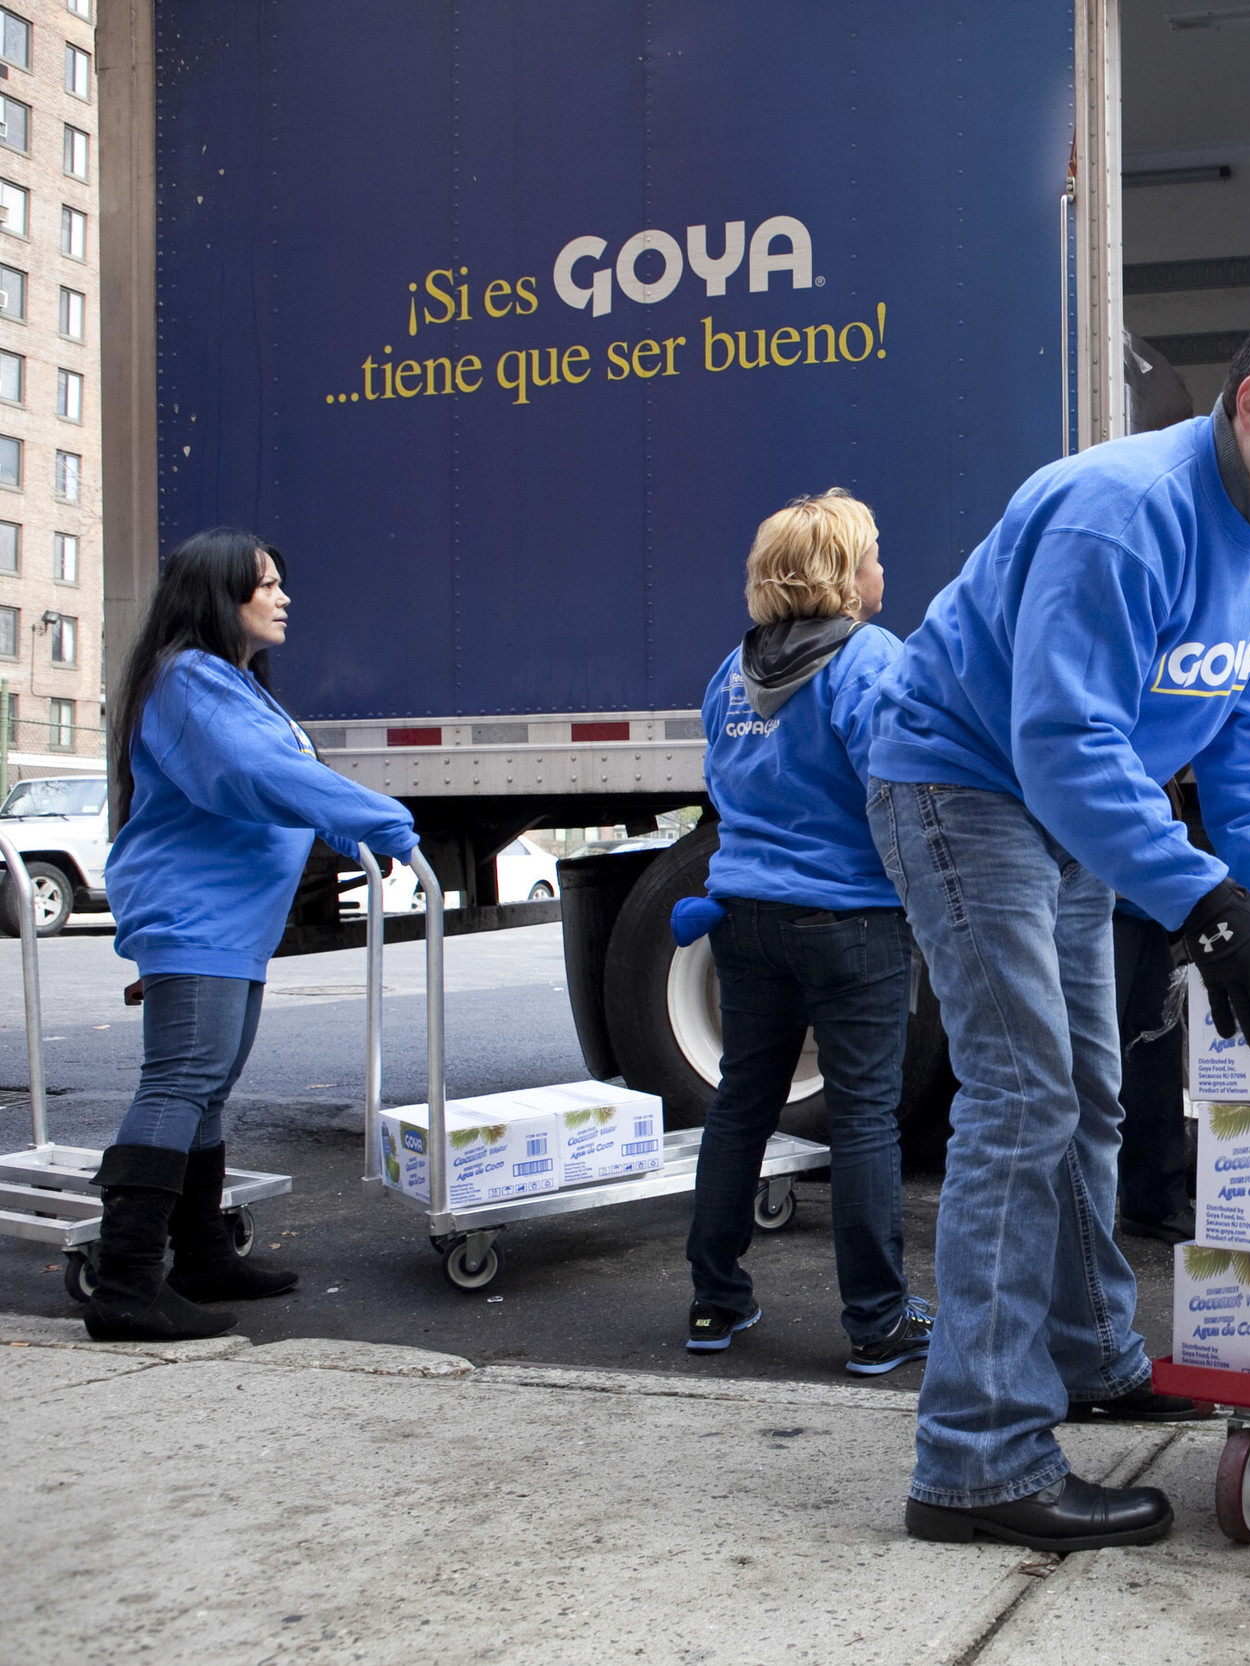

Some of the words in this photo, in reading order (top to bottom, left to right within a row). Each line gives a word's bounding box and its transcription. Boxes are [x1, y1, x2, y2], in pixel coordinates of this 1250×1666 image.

[408, 266, 473, 336] ¡Si
[484, 276, 539, 318] es
[553, 215, 813, 318] GOYA
[326, 345, 484, 404] ...tiene
[496, 345, 591, 405] que
[607, 336, 687, 380] ser
[700, 301, 886, 372] bueno!
[485, 1161, 504, 1173] Coco
